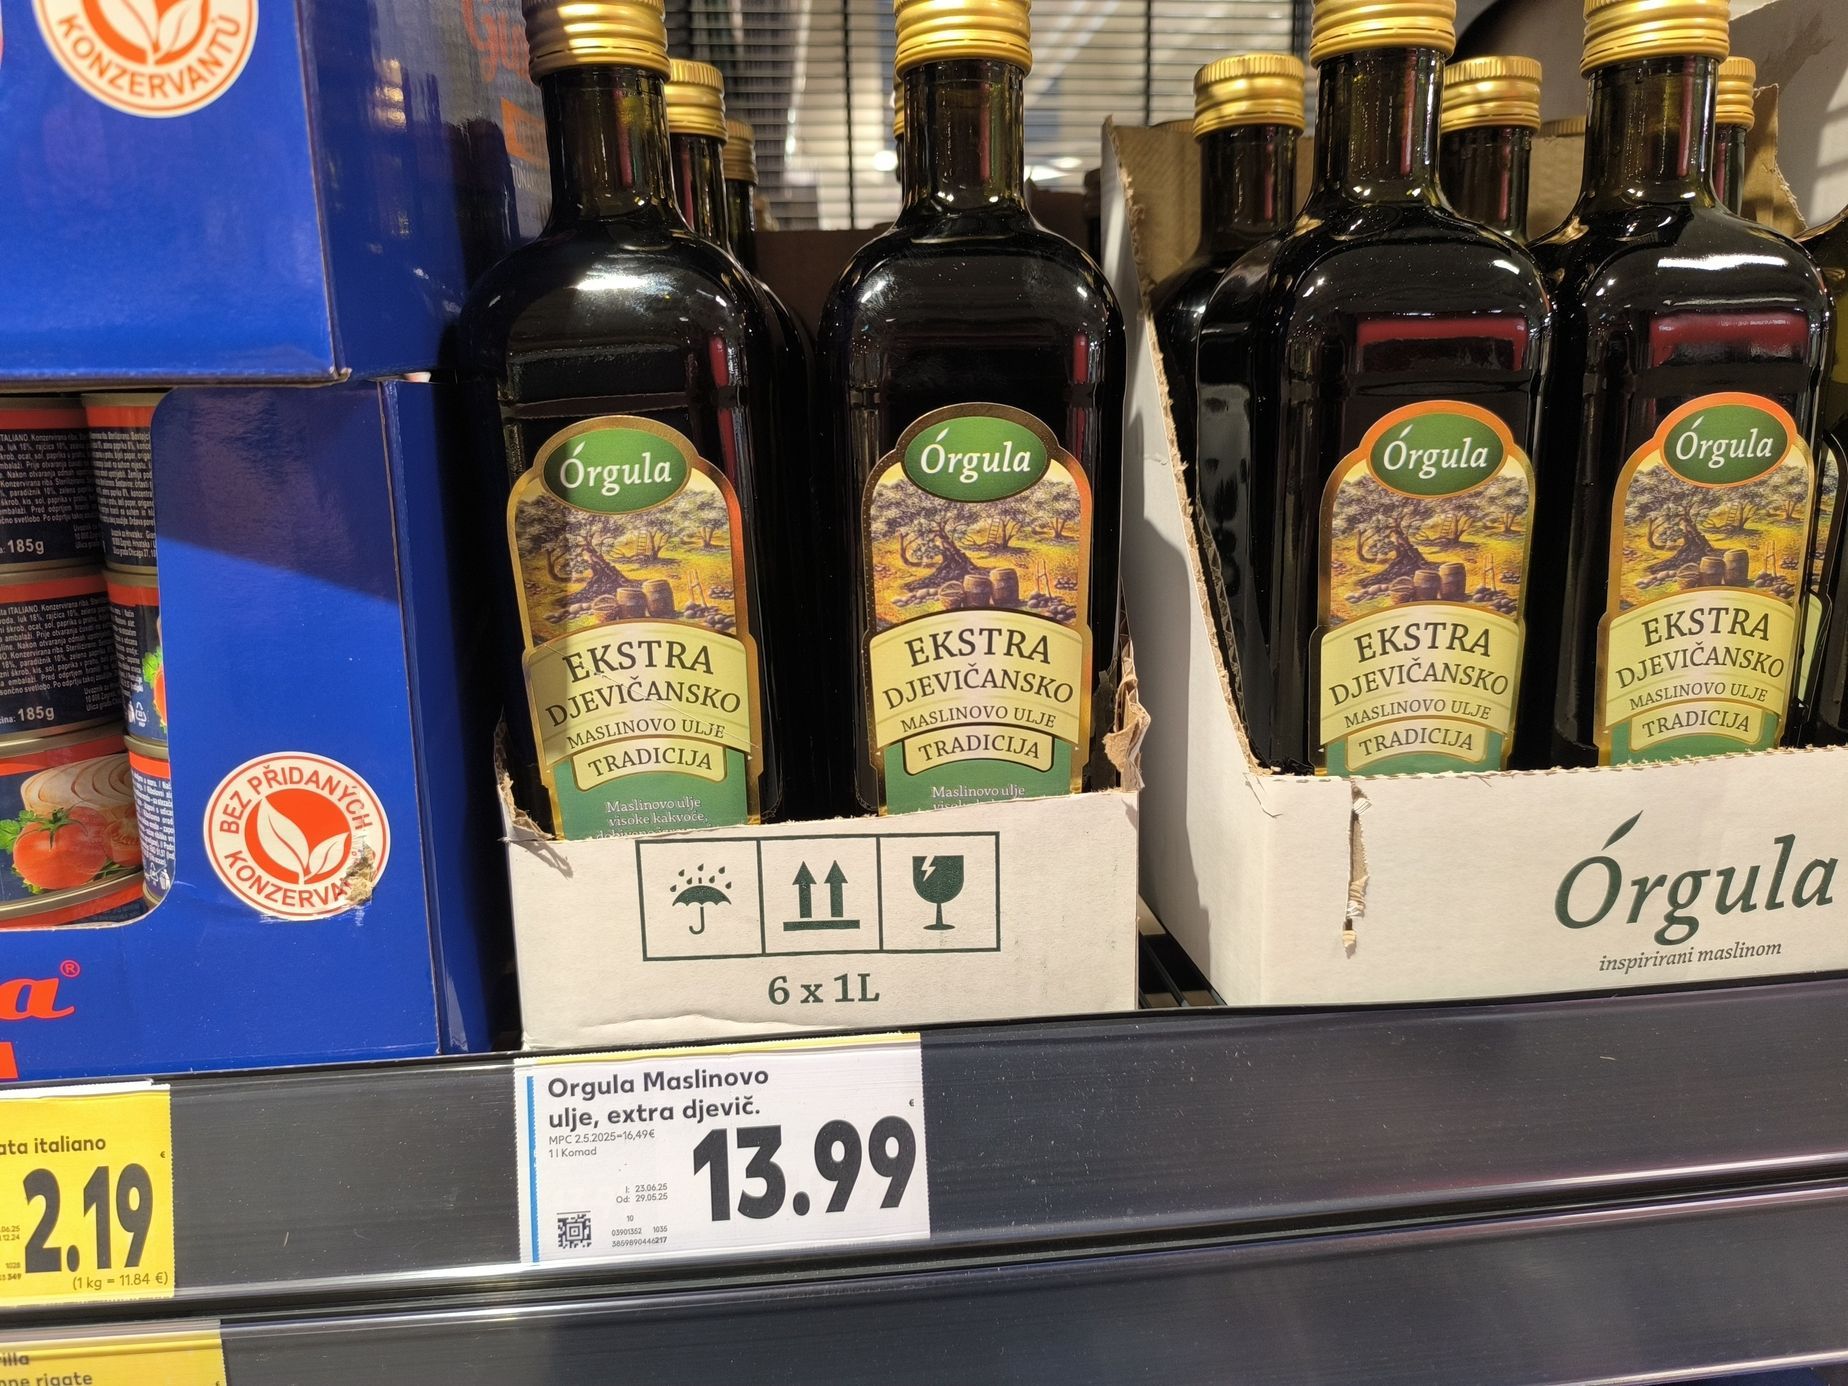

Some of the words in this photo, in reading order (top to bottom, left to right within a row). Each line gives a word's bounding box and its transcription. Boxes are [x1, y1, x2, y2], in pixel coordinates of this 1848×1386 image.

[920, 427, 1031, 484] Órgula
[1383, 424, 1489, 479] Órgula
[1675, 416, 1774, 469] Órgula
[559, 441, 673, 497] Órgula
[7, 538, 45, 555] 185g
[1354, 622, 1491, 663] EKSTRA
[1641, 607, 1770, 647] EKSTRA
[562, 640, 714, 683] EKSTRA
[904, 628, 1051, 667] EKSTRA
[1616, 641, 1784, 689] DJEVIČANSKO
[882, 662, 1073, 709] DJEVIČANSKO
[1329, 657, 1509, 706] DJEVIČANSKO
[1630, 682, 1725, 711] MASLINOVO
[1730, 683, 1768, 702] ULJE
[18, 705, 55, 722] 185g
[545, 676, 741, 727] DJEVIČANSKO
[1344, 699, 1446, 728] MASLINOVO
[1451, 700, 1491, 720] ULJE
[566, 718, 676, 749] MASLINOVO
[682, 719, 726, 739] ULJE
[900, 705, 1008, 732] MASLINOVO
[1014, 707, 1056, 728] ULJE
[1642, 709, 1749, 738] TRADICIJA
[918, 734, 1040, 761] TRADICIJA
[1359, 727, 1473, 756] TRADICIJA
[588, 747, 713, 777] TRADICIJA
[607, 799, 674, 813] Maslinovo
[676, 796, 701, 810] ulje
[932, 785, 999, 798] Maslinovo
[1001, 784, 1025, 799] ulje
[220, 790, 252, 834] BEZ
[609, 814, 650, 827] visoke
[1554, 810, 1839, 946] Órgula
[1599, 946, 1693, 975] inspirirani
[1697, 941, 1782, 963] maslinom
[768, 976, 790, 1005] 6
[800, 984, 823, 1003] x
[834, 973, 880, 1002] 1L
[548, 1073, 635, 1101] Orgula
[643, 1067, 769, 1096] Maslinovo
[549, 1105, 599, 1132] ulje,
[607, 1105, 674, 1125] extra
[682, 1095, 760, 1123] djevič.
[34, 1135, 106, 1154] italiano
[549, 1135, 572, 1145] MPC
[561, 1146, 597, 1158] Komad
[692, 1115, 917, 1222] 13.99
[635, 1183, 668, 1193] 23.06.25
[635, 1193, 668, 1202] 29.05.25
[23, 1162, 154, 1273] 2.19
[86, 1276, 102, 1290] kg
[119, 1273, 150, 1286] 11.84
[0, 1352, 29, 1366] illa
